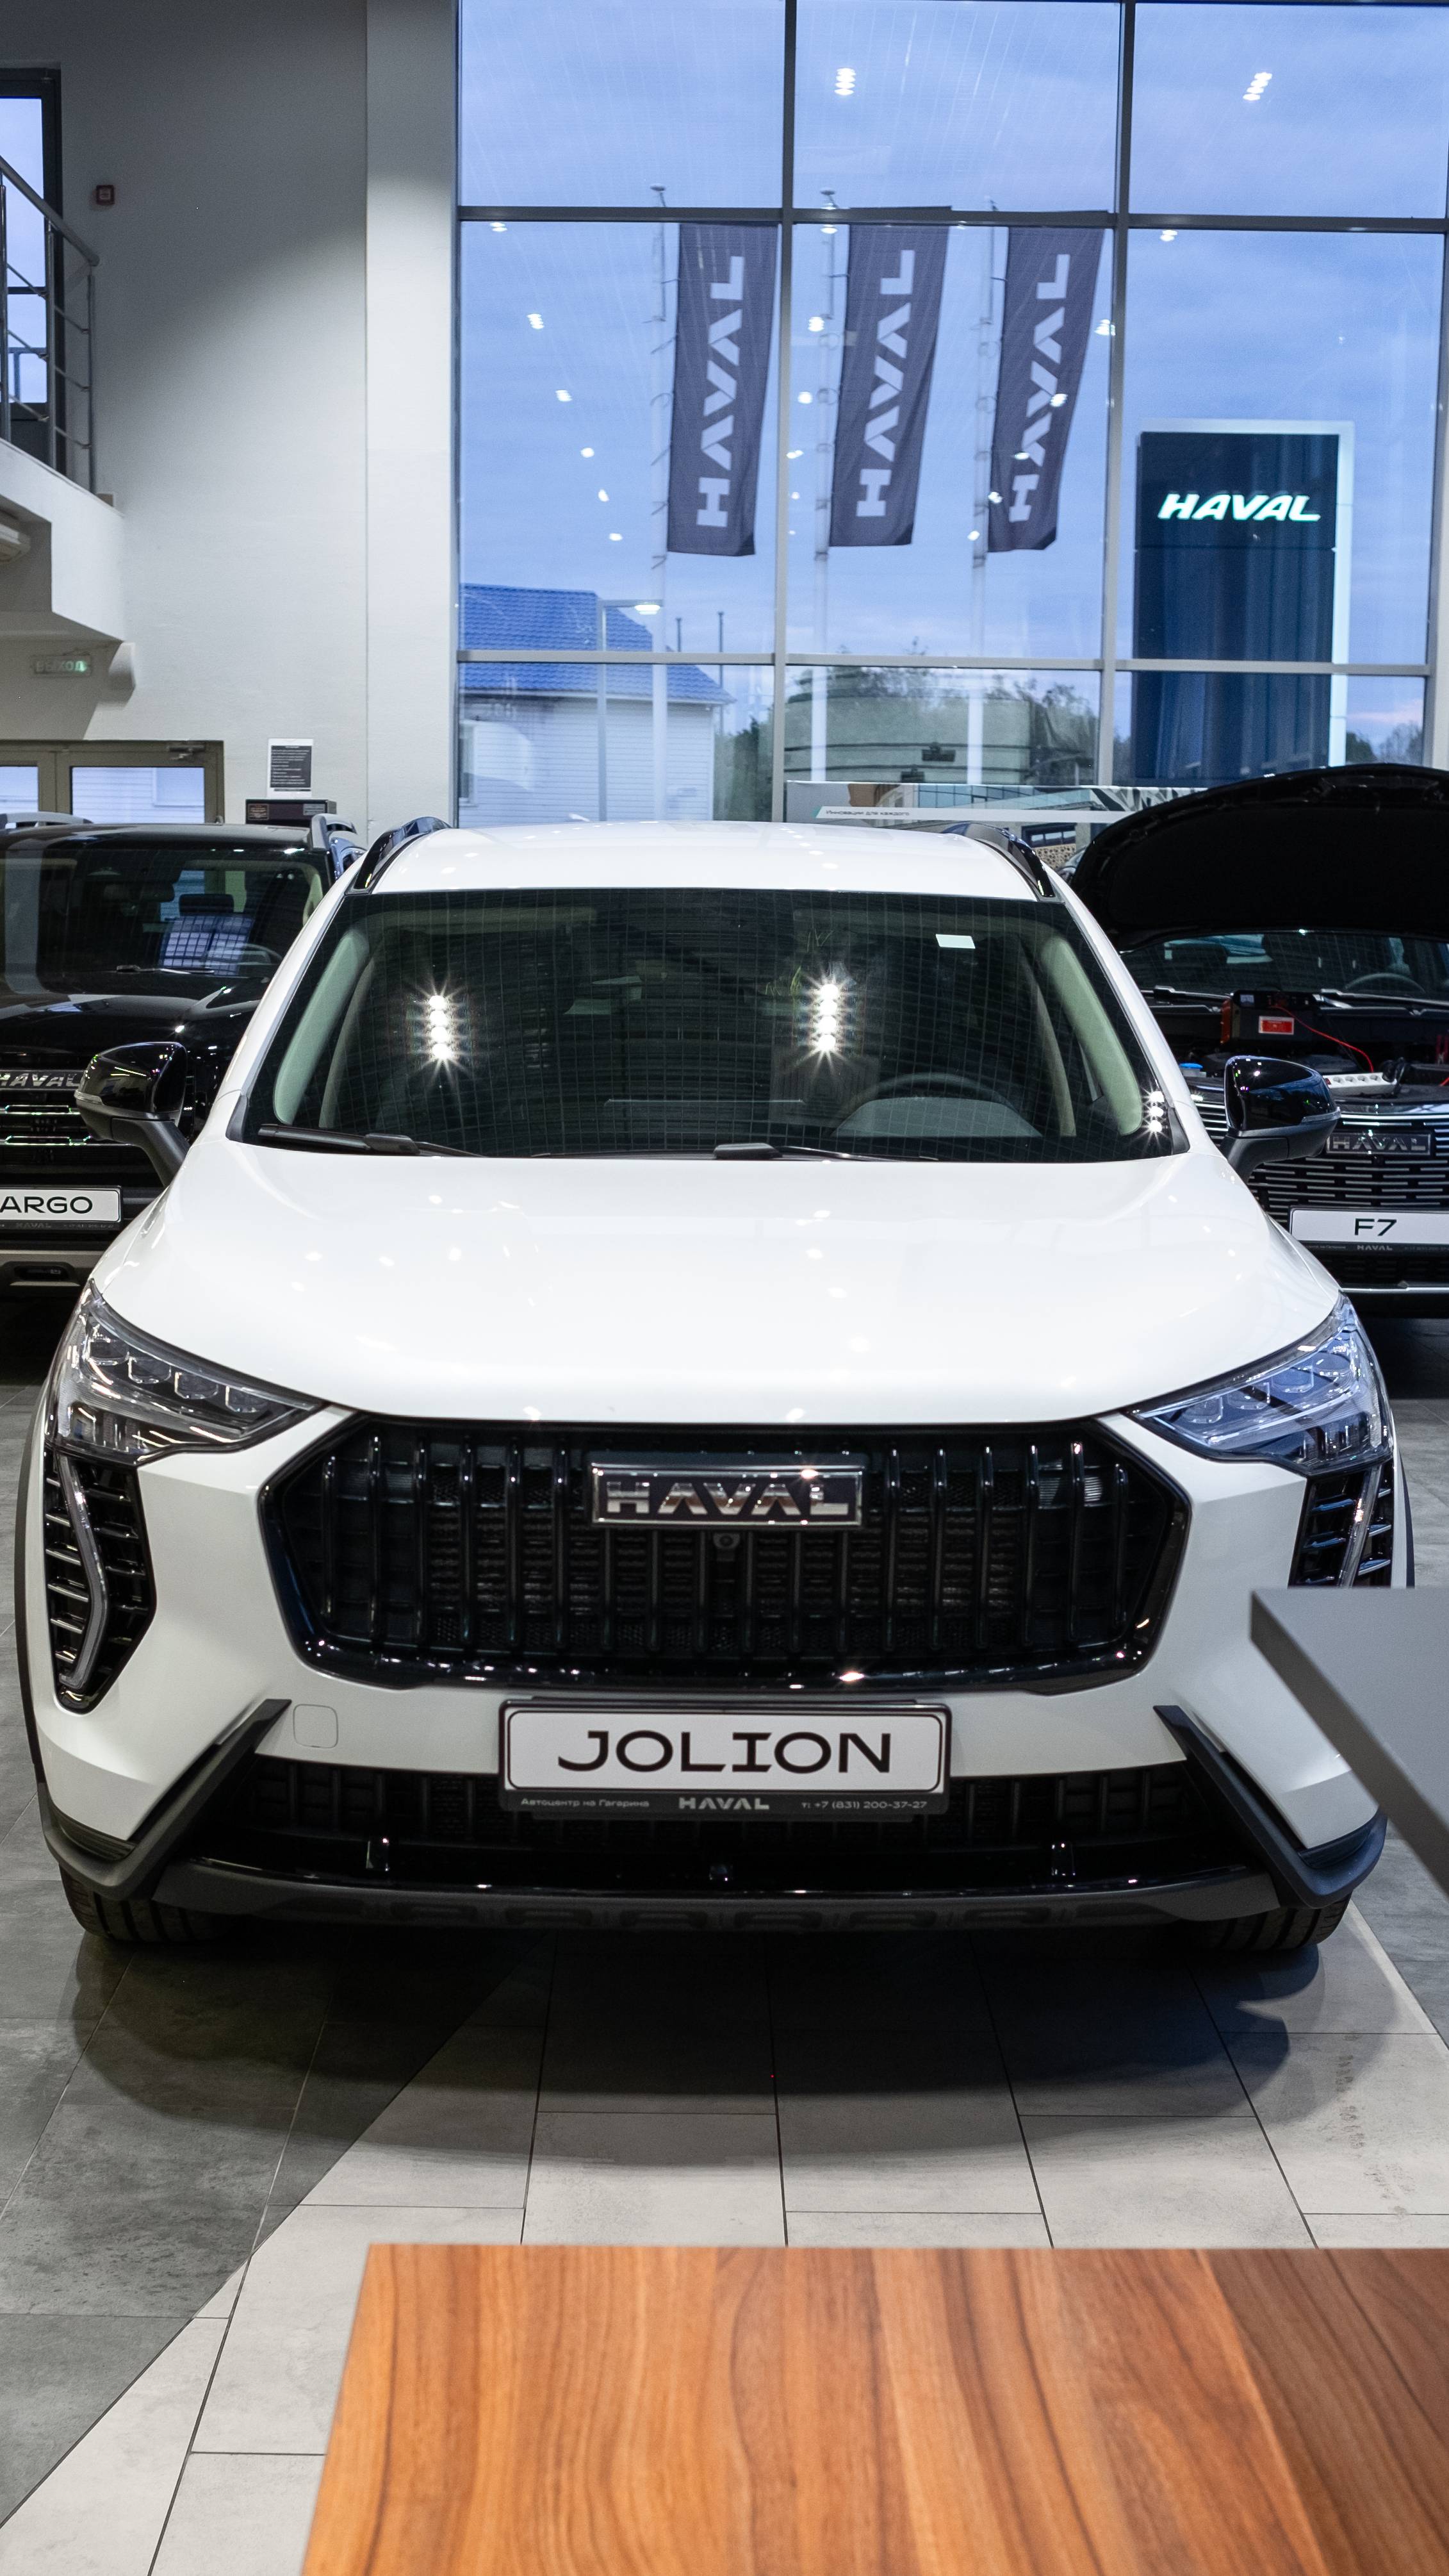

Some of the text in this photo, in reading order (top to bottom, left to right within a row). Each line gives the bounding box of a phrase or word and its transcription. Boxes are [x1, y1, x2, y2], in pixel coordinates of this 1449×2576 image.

[696, 256, 744, 527] HAVAL
[856, 250, 915, 516] HAVAL
[1008, 254, 1070, 523] HAVAL
[1158, 493, 1321, 522] HAVAL
[1332, 1136, 1426, 1151] HAVAL
[1354, 1218, 1397, 1237] F7
[607, 1482, 849, 1515] HAVAL
[558, 1730, 891, 1774] JOLION
[521, 1797, 580, 1807] Автоцентр
[598, 1798, 650, 1808] Гагарина
[679, 1797, 769, 1810] HAVAL
[832, 1801, 860, 1810] (831)
[864, 1801, 928, 1809] 200-37-27
